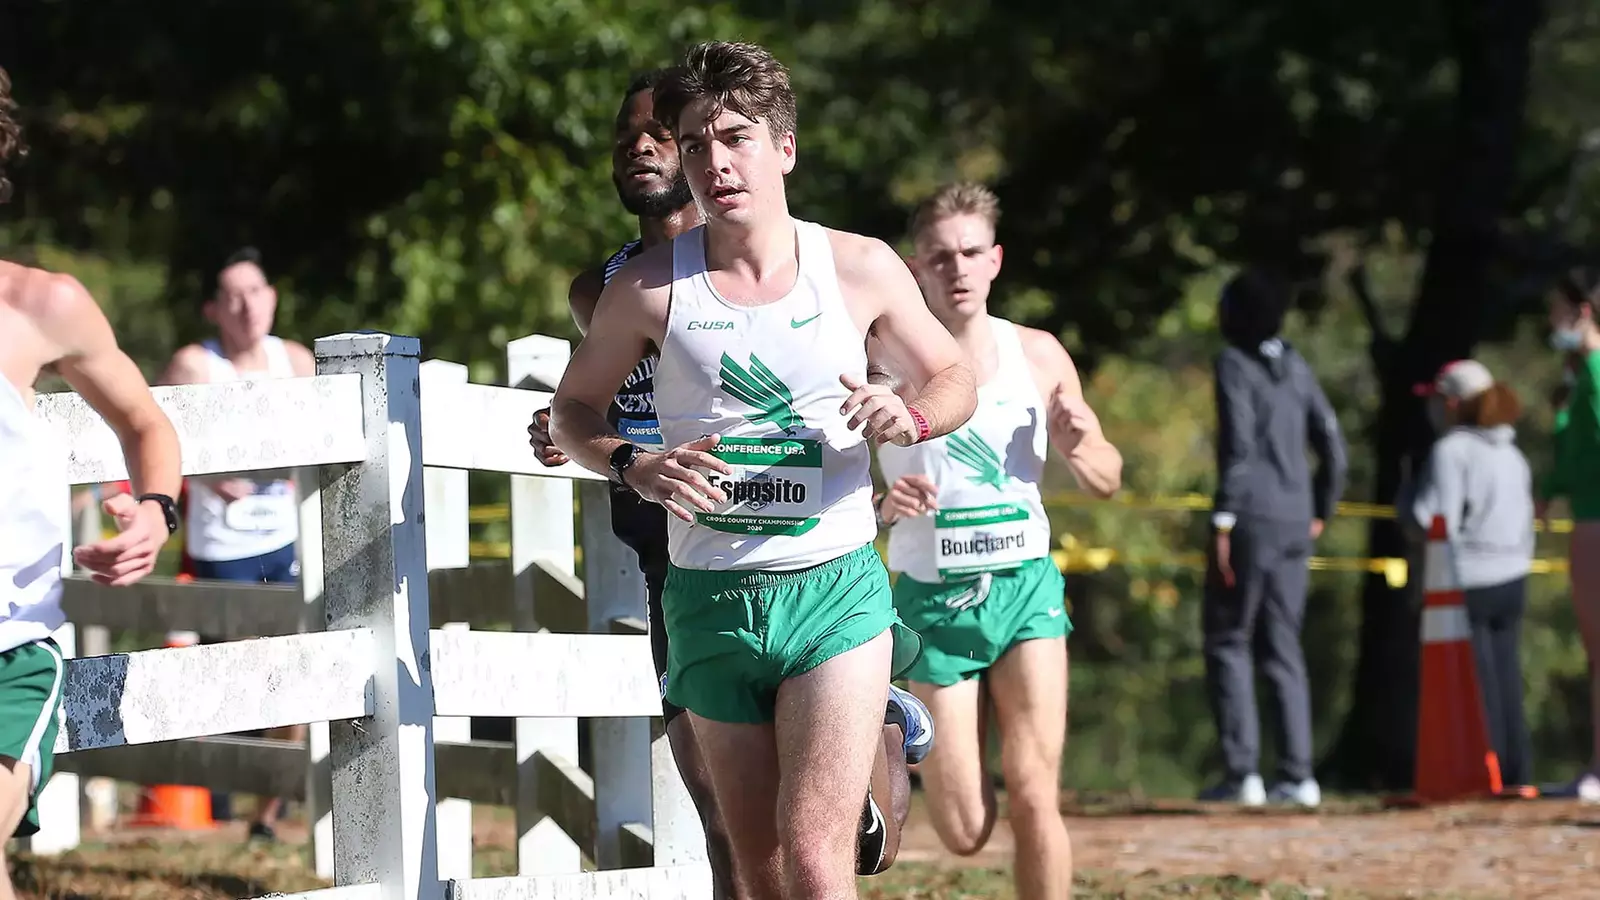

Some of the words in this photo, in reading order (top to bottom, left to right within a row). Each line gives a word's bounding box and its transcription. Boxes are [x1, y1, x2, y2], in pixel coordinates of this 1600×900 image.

[626, 426, 661, 435] CONFERE
[784, 446, 806, 456] USA
[727, 517, 757, 525] COUNTRY
[941, 530, 1025, 557] Bouchard
